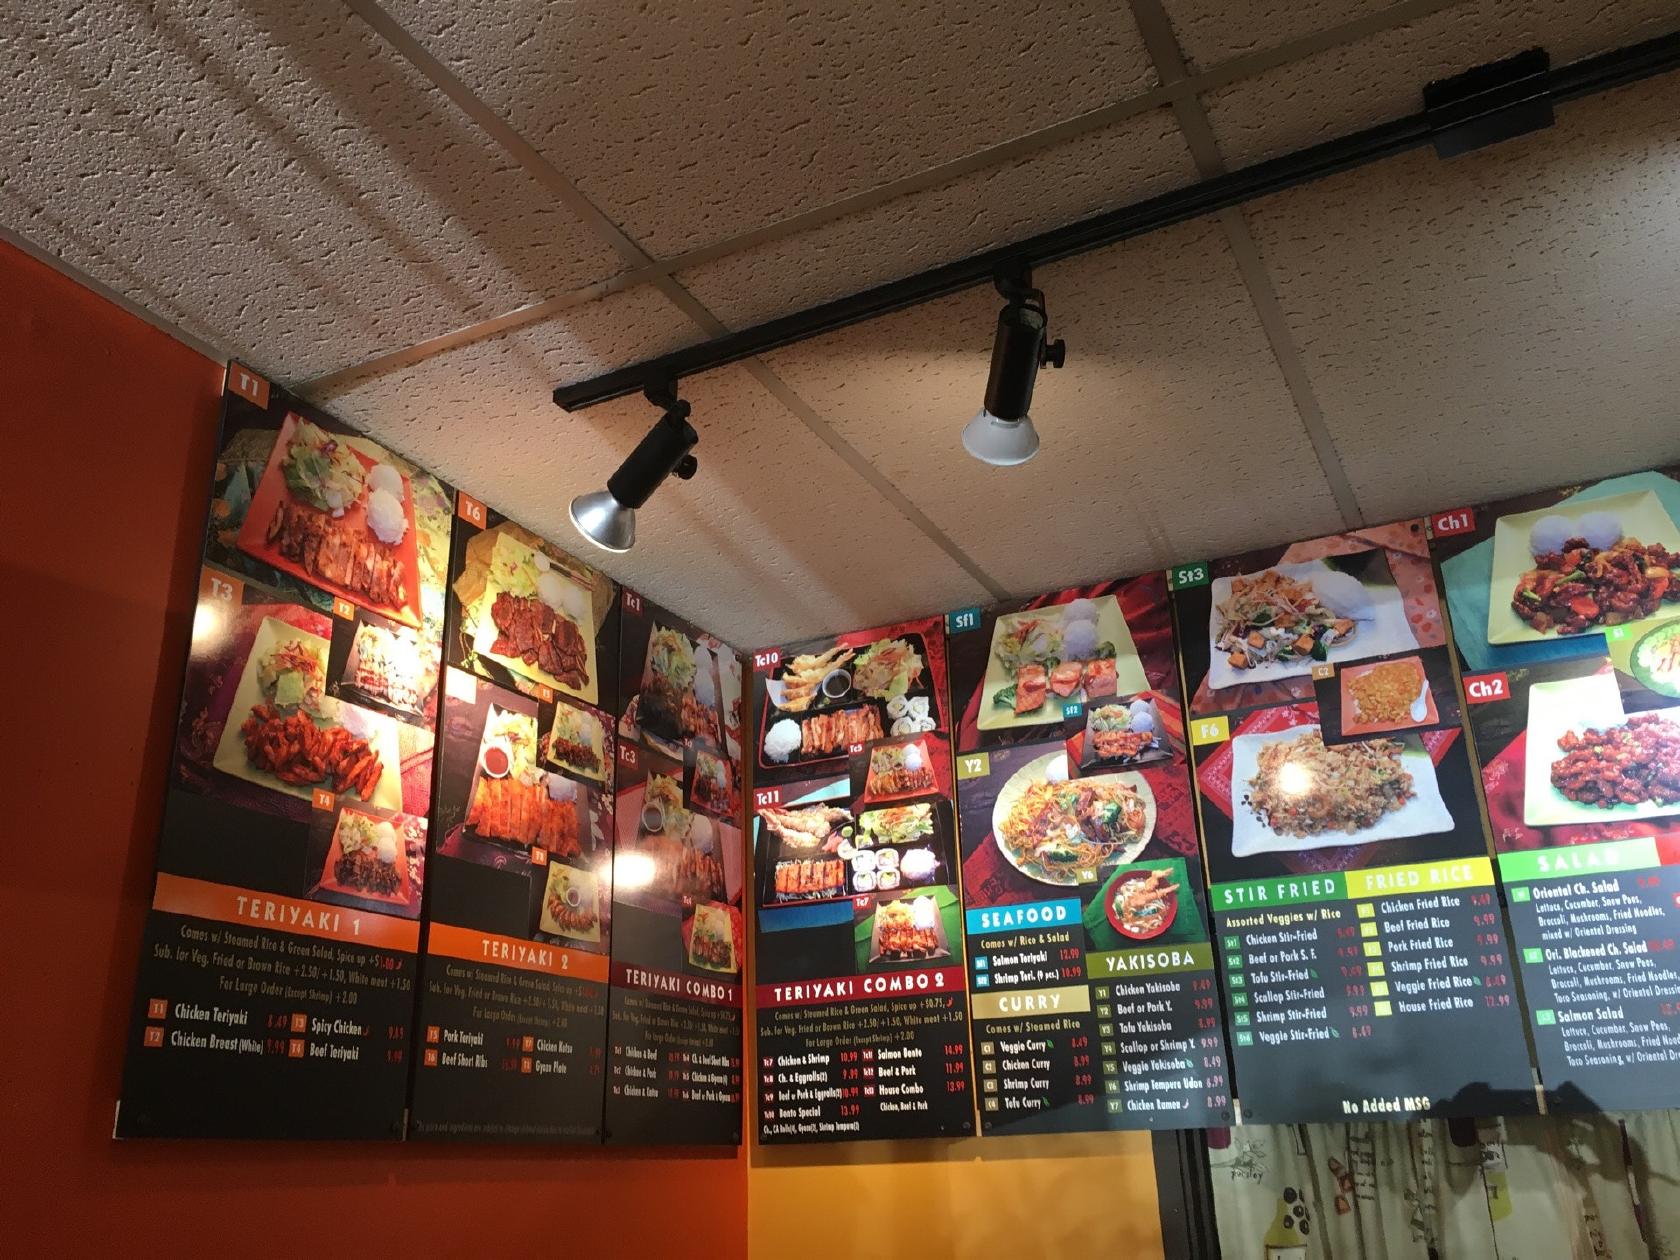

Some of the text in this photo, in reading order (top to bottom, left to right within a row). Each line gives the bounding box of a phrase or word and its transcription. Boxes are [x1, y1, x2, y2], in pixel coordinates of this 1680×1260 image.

[239, 373, 258, 396] T1
[466, 500, 481, 521] T6
[1438, 513, 1469, 532] Ch1
[1179, 568, 1204, 584] St3
[211, 578, 232, 601] T3
[626, 592, 640, 611] Tc1
[956, 614, 974, 627] Sf1
[755, 653, 778, 666] Tc10
[1468, 679, 1503, 698] Ch2
[1201, 725, 1219, 738] F6
[620, 746, 636, 764] Tc3
[850, 744, 863, 753] Tc5
[965, 759, 982, 773] Y2
[319, 795, 330, 806] T4
[757, 791, 779, 806] Tc11
[1537, 848, 1619, 872] SALAD
[1366, 864, 1473, 891] FRIED RICE
[1224, 879, 1335, 904] STIR FRIED
[1533, 878, 1619, 899] Oriental Ch. Salad
[1381, 900, 1414, 914] Chicken
[1417, 897, 1439, 908] Fried
[1441, 896, 1460, 907] Rice
[236, 895, 360, 935] TERIYAKI 1
[981, 905, 1066, 928] SEAFOOD
[1226, 908, 1341, 928] Assorted Veggies w/ Rice
[1384, 921, 1404, 933] Beef
[1407, 918, 1429, 930] Fried
[1431, 917, 1450, 928] Rice
[981, 931, 1069, 948] Comes w/ Rice & Salad
[1246, 928, 1318, 945] Chicken Stir-Fried
[1388, 937, 1453, 952] Pork Fried Rice
[482, 940, 568, 969] TERIYAKI 2
[992, 951, 1047, 967] Salmon Teriyaki
[1249, 948, 1317, 964] Beef or Pork S. F.
[1545, 948, 1562, 961] Ori.
[1563, 944, 1605, 959] Blackened
[1607, 943, 1621, 955] Ch.
[1623, 940, 1648, 954] Salad
[1106, 951, 1194, 972] YAKISOBA
[1391, 961, 1422, 973] Shrimp
[1424, 956, 1447, 968] Fried
[1450, 956, 1468, 966] Rice
[626, 969, 732, 1001] TERIYAKI COMBO 1
[994, 972, 1018, 985] Shrimp
[1251, 969, 1309, 984] Tofu Stir-Fried
[775, 972, 944, 1002] TERIYAKI COMBO 2
[1116, 981, 1180, 996] Chicken Yakisoba
[1394, 980, 1426, 995] Veggie
[1428, 976, 1450, 989] Fried
[1453, 976, 1472, 987] Rice
[998, 994, 1060, 1012] CURRY
[1254, 986, 1325, 1004] Scallop Stir-Fried
[1117, 1003, 1134, 1015] Beef
[1137, 1004, 1145, 1013] or
[1147, 1000, 1164, 1012] Pork
[1166, 1000, 1173, 1011] Y.
[1398, 996, 1473, 1013] House Fried Rice
[175, 1004, 248, 1026] Chicken Teriyaki
[1256, 1006, 1327, 1024] Shrimp Stir-Fried
[1558, 1009, 1594, 1023] Salmon
[1597, 1005, 1624, 1019] Salad
[312, 1018, 362, 1036] Spicy Chicken
[1119, 1019, 1172, 1034] Tofu Yakisoba
[171, 1031, 238, 1050] Chicken Breast
[1259, 1026, 1329, 1045] Veggie Stir-Fried
[310, 1043, 359, 1061] Beef Teriyaki
[878, 1049, 901, 1060] Salmon
[903, 1047, 922, 1058] Bento
[1000, 1040, 1046, 1054] Veggie Curry
[1120, 1041, 1148, 1054] Scallop
[1160, 1039, 1188, 1052] Shrimp
[778, 1053, 830, 1067] Chicken & Shrimp
[1002, 1058, 1050, 1071] Chicken Curry
[1122, 1058, 1185, 1075] Veggie Yakisoba
[878, 1065, 916, 1077] Beef & Pork
[879, 1084, 899, 1095] House
[901, 1082, 924, 1094] Combo
[1004, 1077, 1049, 1091] Shrimp Curry
[1124, 1077, 1203, 1093] Shrimp Tempura Udon
[1005, 1097, 1041, 1109] Tofu Curry
[1127, 1098, 1180, 1111] Chicken Ramen
[1343, 1097, 1431, 1114] No Added MSG
[779, 1105, 821, 1119] Bento Special
